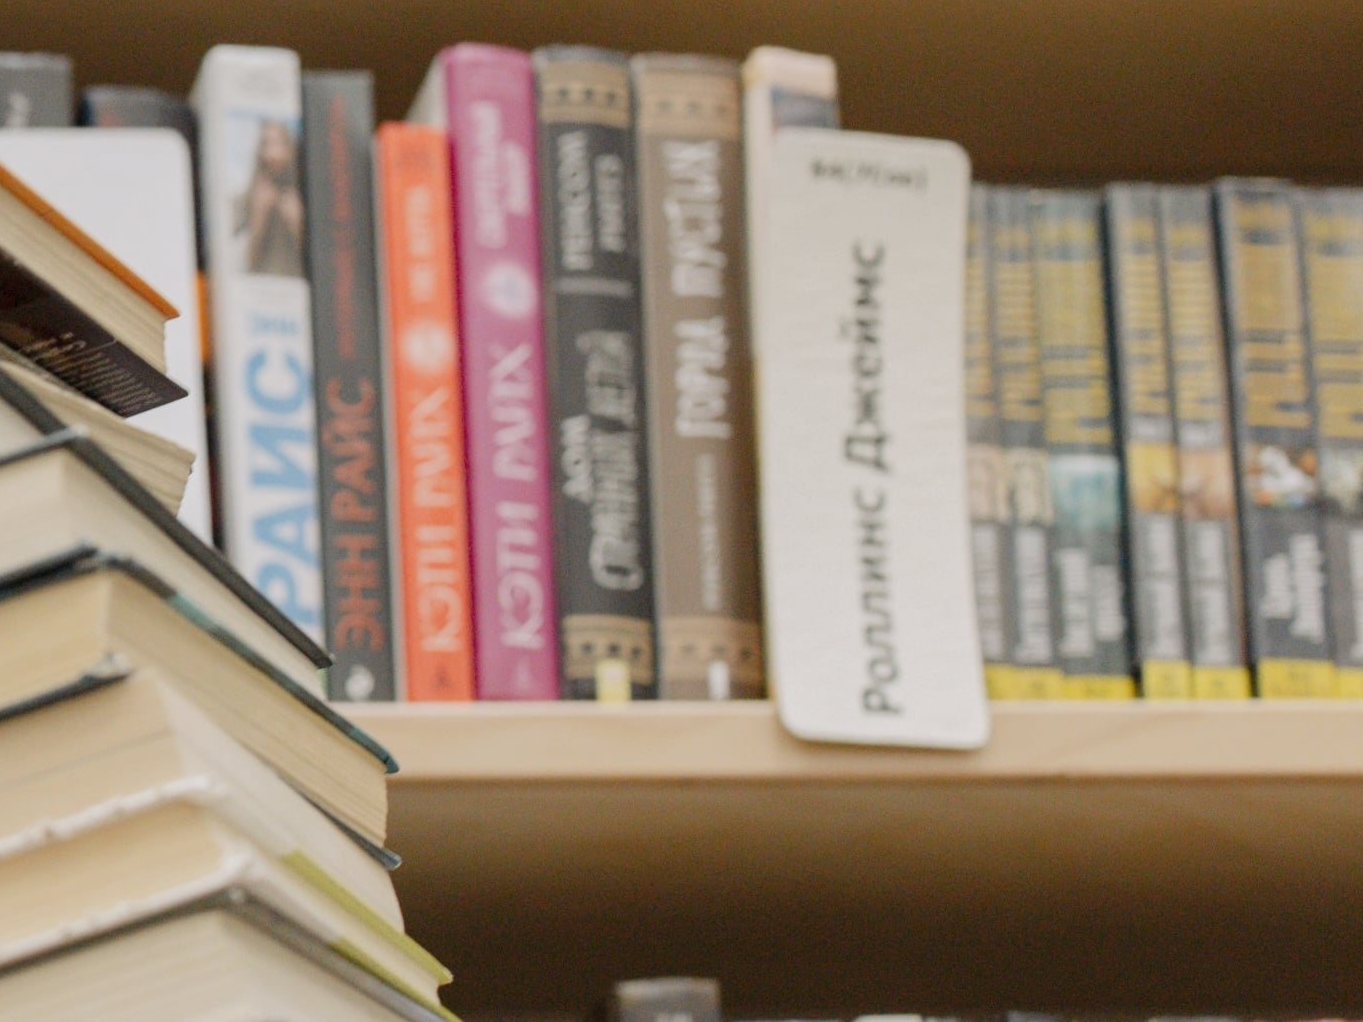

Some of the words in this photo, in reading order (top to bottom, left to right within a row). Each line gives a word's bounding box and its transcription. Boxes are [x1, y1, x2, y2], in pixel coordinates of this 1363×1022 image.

[836, 241, 889, 475] Джеймс
[325, 377, 377, 526] РАЙС
[559, 416, 594, 506] ДОМ
[335, 538, 386, 653] ЭНН
[406, 520, 463, 652] КЭТИ
[497, 503, 548, 650] КЭТИ
[856, 485, 905, 716] Роллинс
